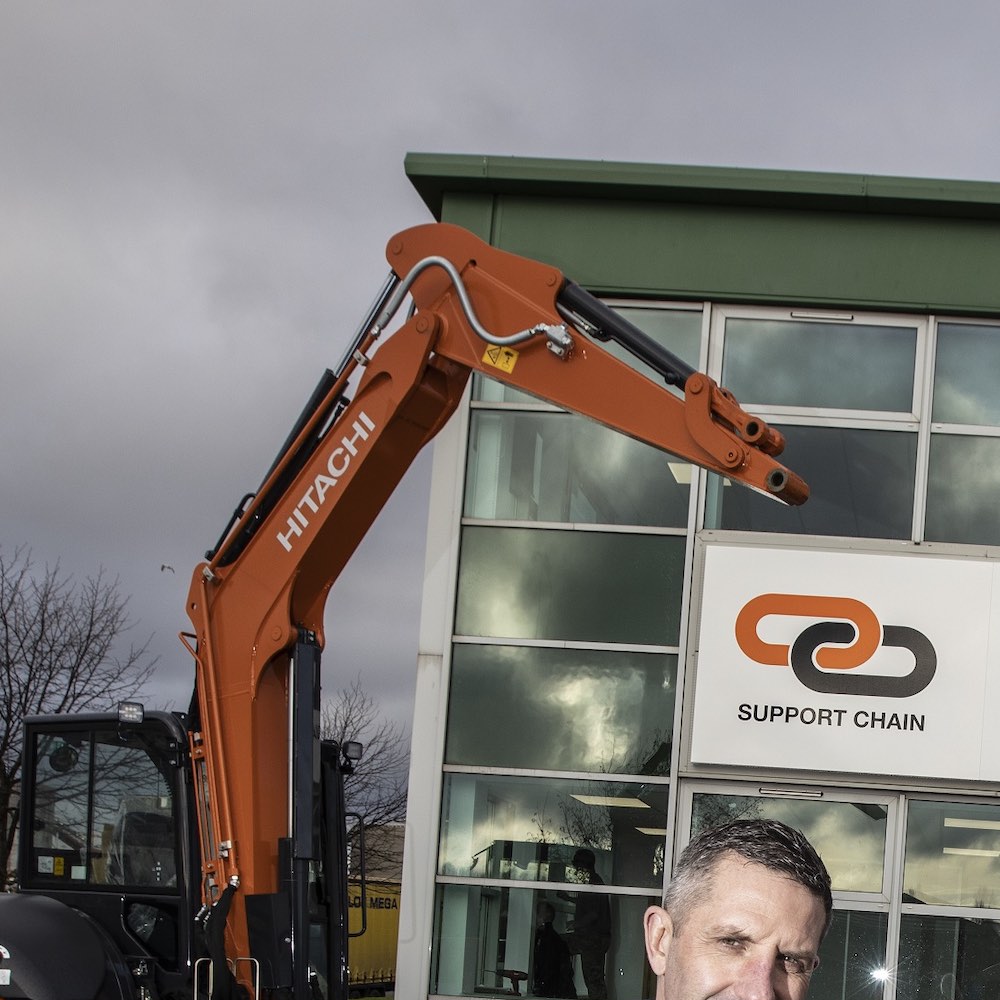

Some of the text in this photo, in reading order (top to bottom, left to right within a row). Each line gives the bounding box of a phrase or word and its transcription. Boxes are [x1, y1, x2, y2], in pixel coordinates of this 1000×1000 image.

[276, 411, 376, 552] HITACHI
[738, 703, 926, 732] SUPPORT CHAIN
[370, 897, 398, 909] MEGA
